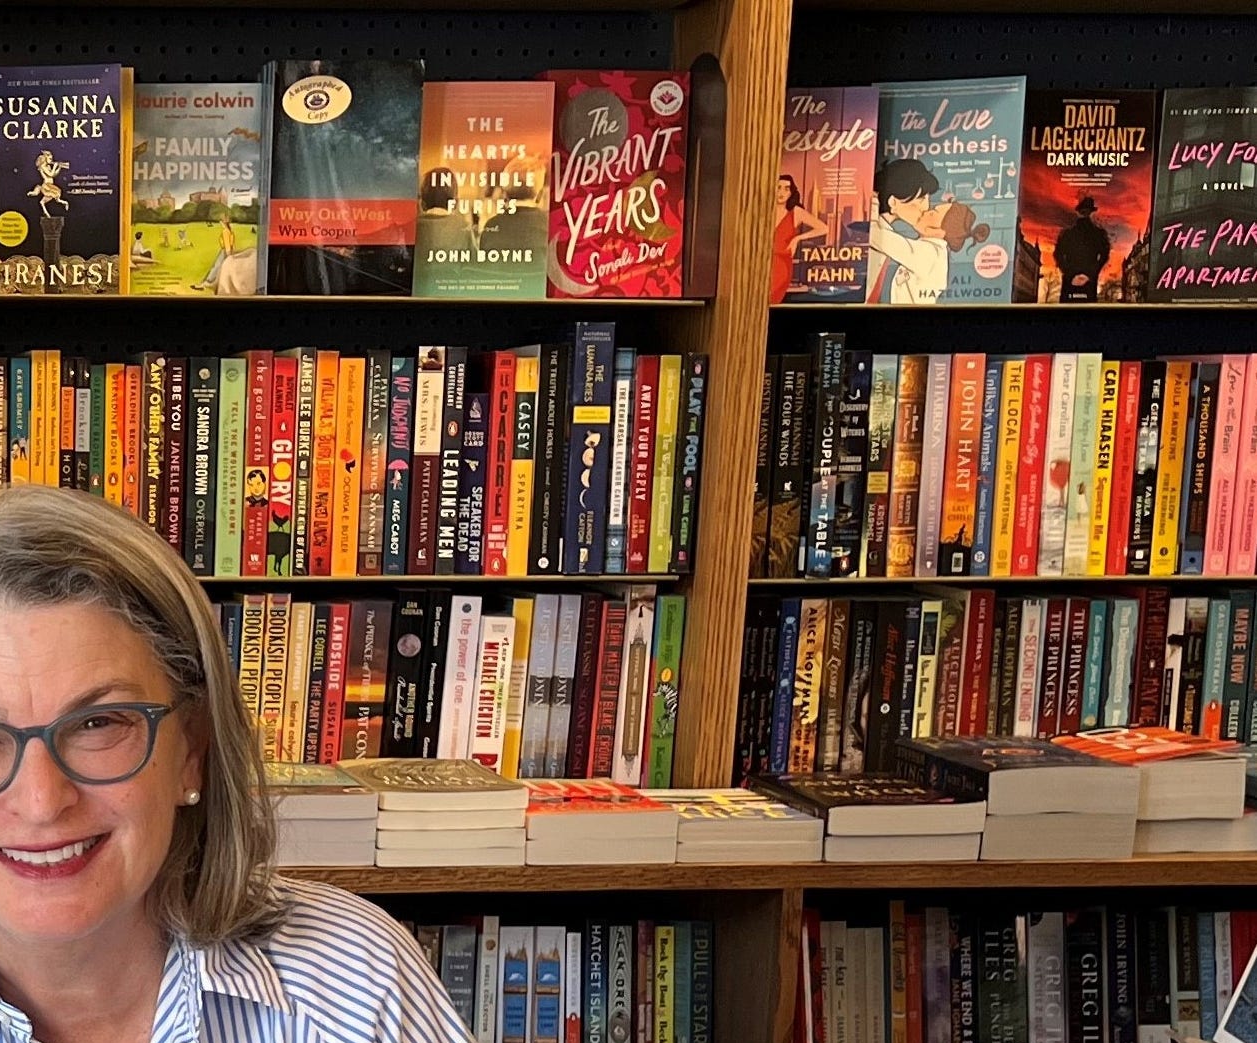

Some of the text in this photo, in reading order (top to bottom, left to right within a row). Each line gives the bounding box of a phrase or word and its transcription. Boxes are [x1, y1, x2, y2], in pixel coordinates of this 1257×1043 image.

[193, 91, 254, 109] colwin
[307, 109, 329, 120] Copy
[792, 96, 826, 115] The
[1064, 104, 1116, 126] DAVID
[2, 118, 104, 139] CLARKE
[467, 117, 503, 131] THE
[587, 107, 620, 138] The
[901, 99, 993, 138] the Love
[443, 145, 526, 159] HEART'S
[884, 137, 1008, 158] Hypothesis
[1031, 126, 1146, 151] LAGERCRANTZ
[134, 160, 254, 181] HAPPINESS
[551, 126, 681, 203] VIBRANT
[1047, 151, 1129, 167] DARK MUSIC
[1169, 141, 1220, 170] LUCY
[431, 171, 535, 187] INVISIBLE
[279, 207, 392, 222] Way Out West
[447, 199, 517, 215] FURIES
[563, 179, 666, 264] YEARS
[278, 224, 308, 238] Wyn
[1161, 224, 1204, 254] THE
[427, 248, 533, 262] JOHN BOYNE
[584, 242, 667, 284] Sonali Dev
[802, 247, 862, 262] TAYLOR
[807, 268, 855, 283] HAHN
[951, 275, 972, 285] ALI
[918, 288, 1002, 299] HAZELWOOD
[150, 362, 162, 389] ANY
[299, 355, 314, 457] JAMES LEE BURKE
[1005, 365, 1022, 445] THE LOCAL
[1098, 370, 1117, 469] CARL HIAASEN
[517, 402, 531, 451] CASEY
[956, 381, 976, 491] JOHN HART
[195, 407, 210, 495] SANDRA BROWN
[635, 384, 652, 501] AWAIT YOUR REPLY
[438, 449, 459, 559] LEADING MEN
[472, 487, 482, 538] SPEAKER
[390, 500, 400, 555] MEG CABOT
[457, 498, 470, 552] THE DEAD
[265, 609, 287, 715] BOOKISH PEOPLE
[328, 617, 345, 690] LANDSLIDE
[1044, 611, 1063, 717] THE PRINCESS
[1066, 609, 1085, 716] THE PRINCESS
[476, 641, 500, 738] MICHAEL CRICHTON
[590, 925, 601, 985] HATCHET
